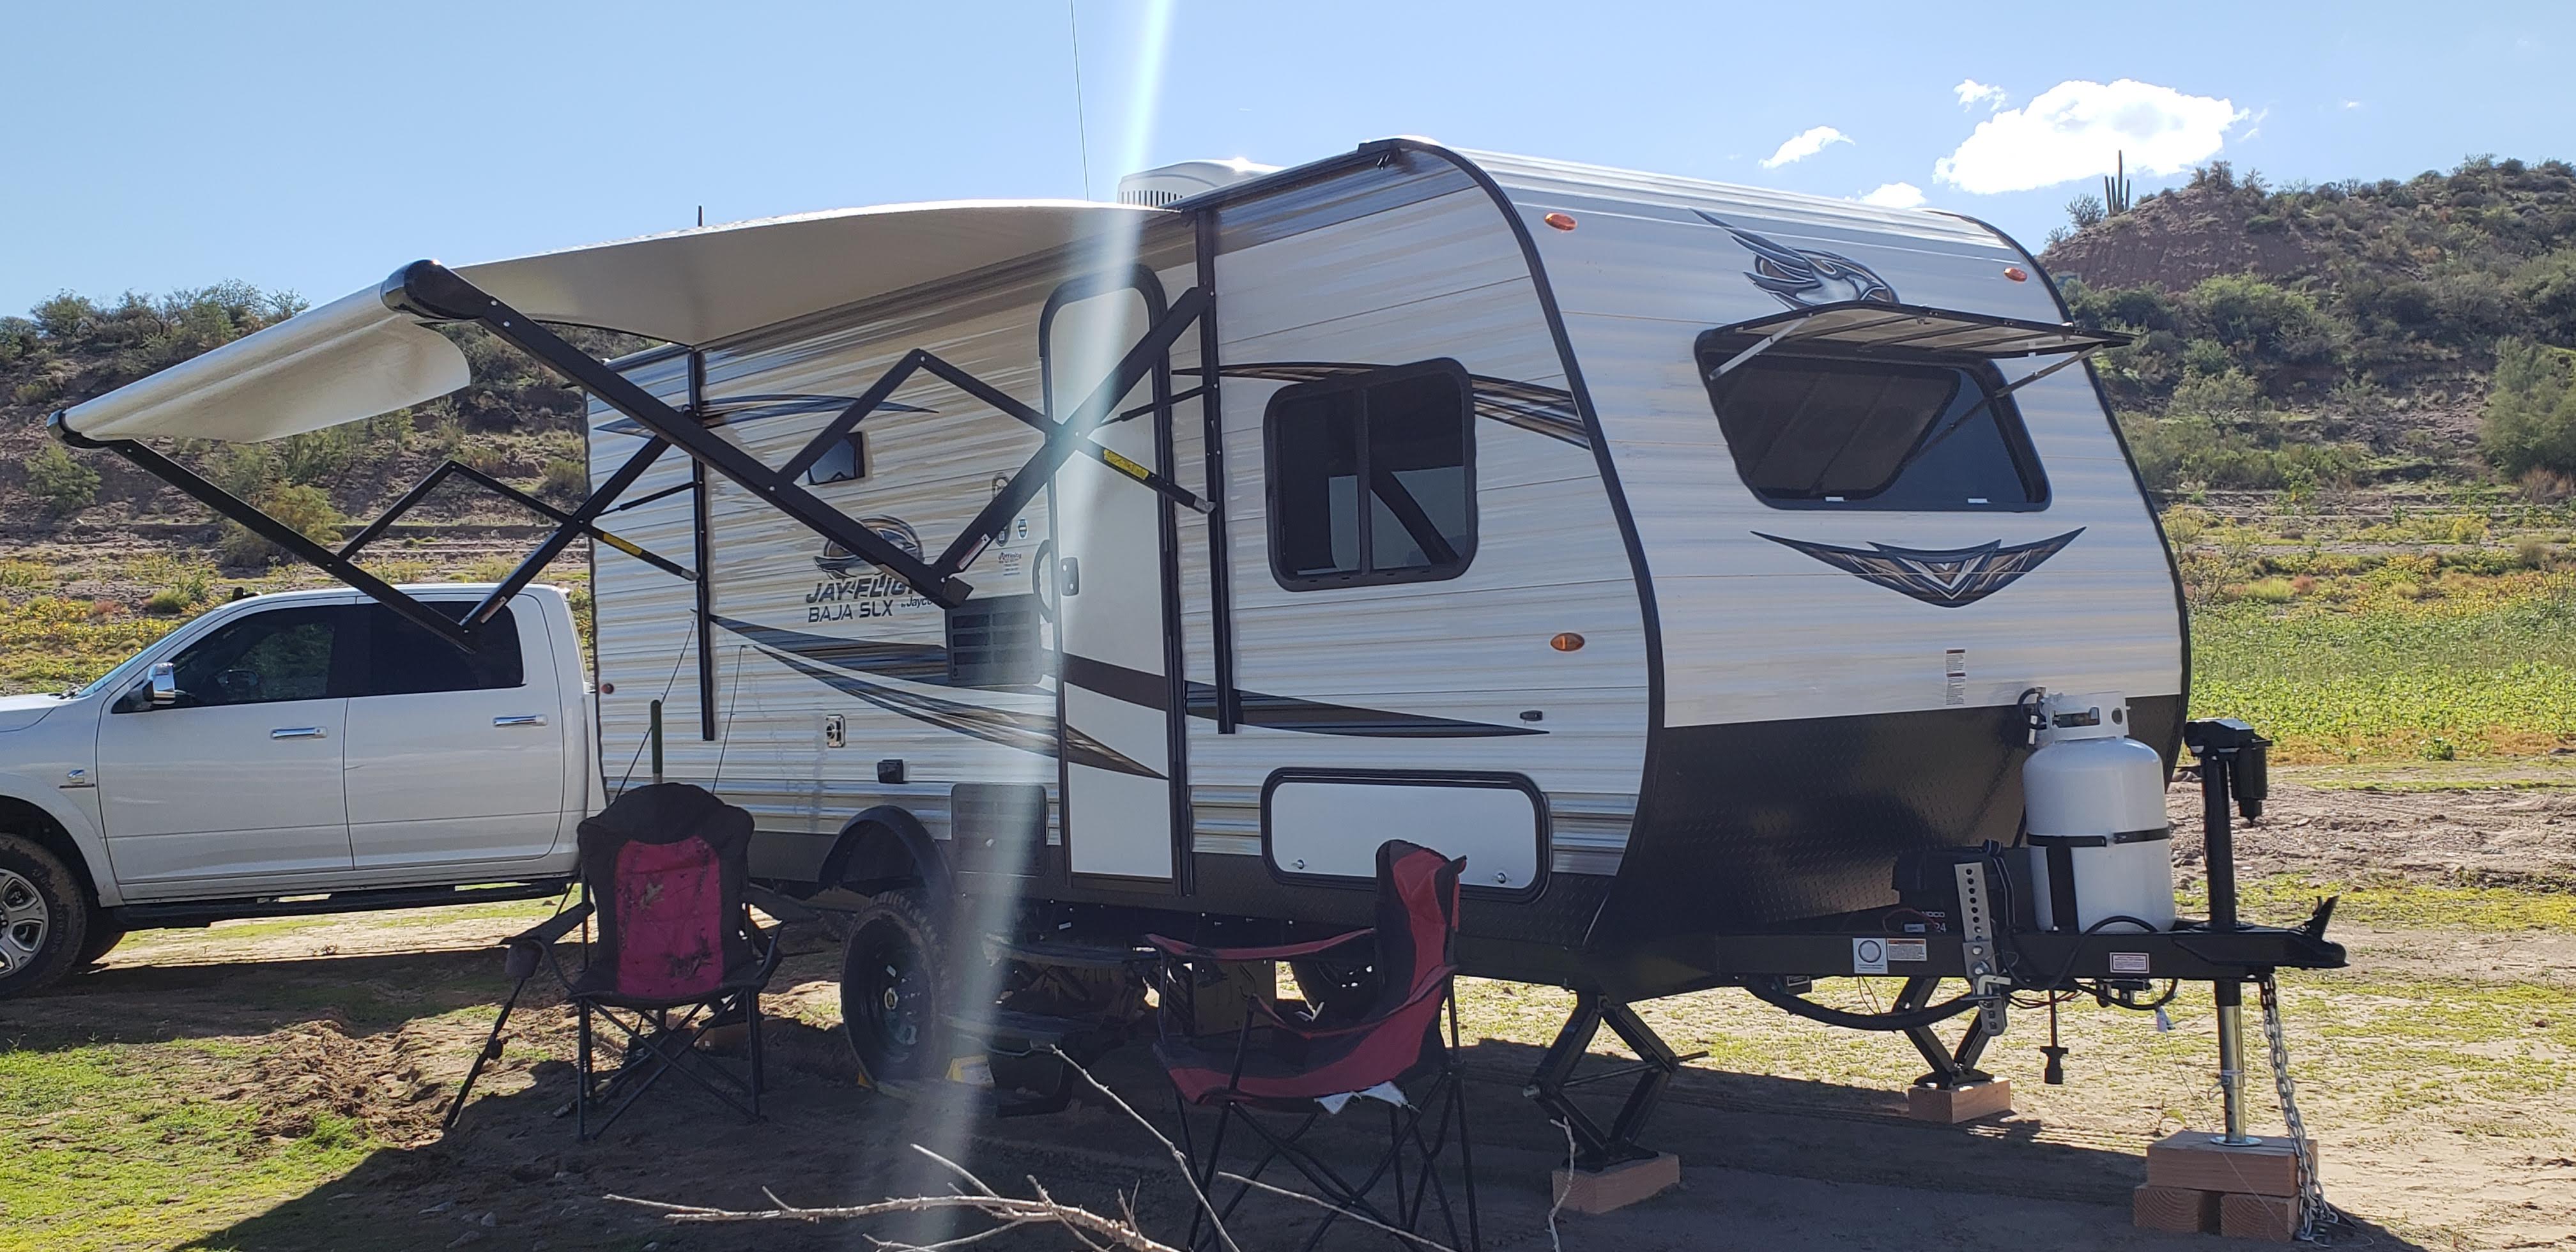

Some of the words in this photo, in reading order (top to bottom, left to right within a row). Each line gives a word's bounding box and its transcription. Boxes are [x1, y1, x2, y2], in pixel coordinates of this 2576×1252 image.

[854, 576, 913, 599] FLIG
[808, 604, 853, 623] BAJA
[859, 599, 893, 618] SLX
